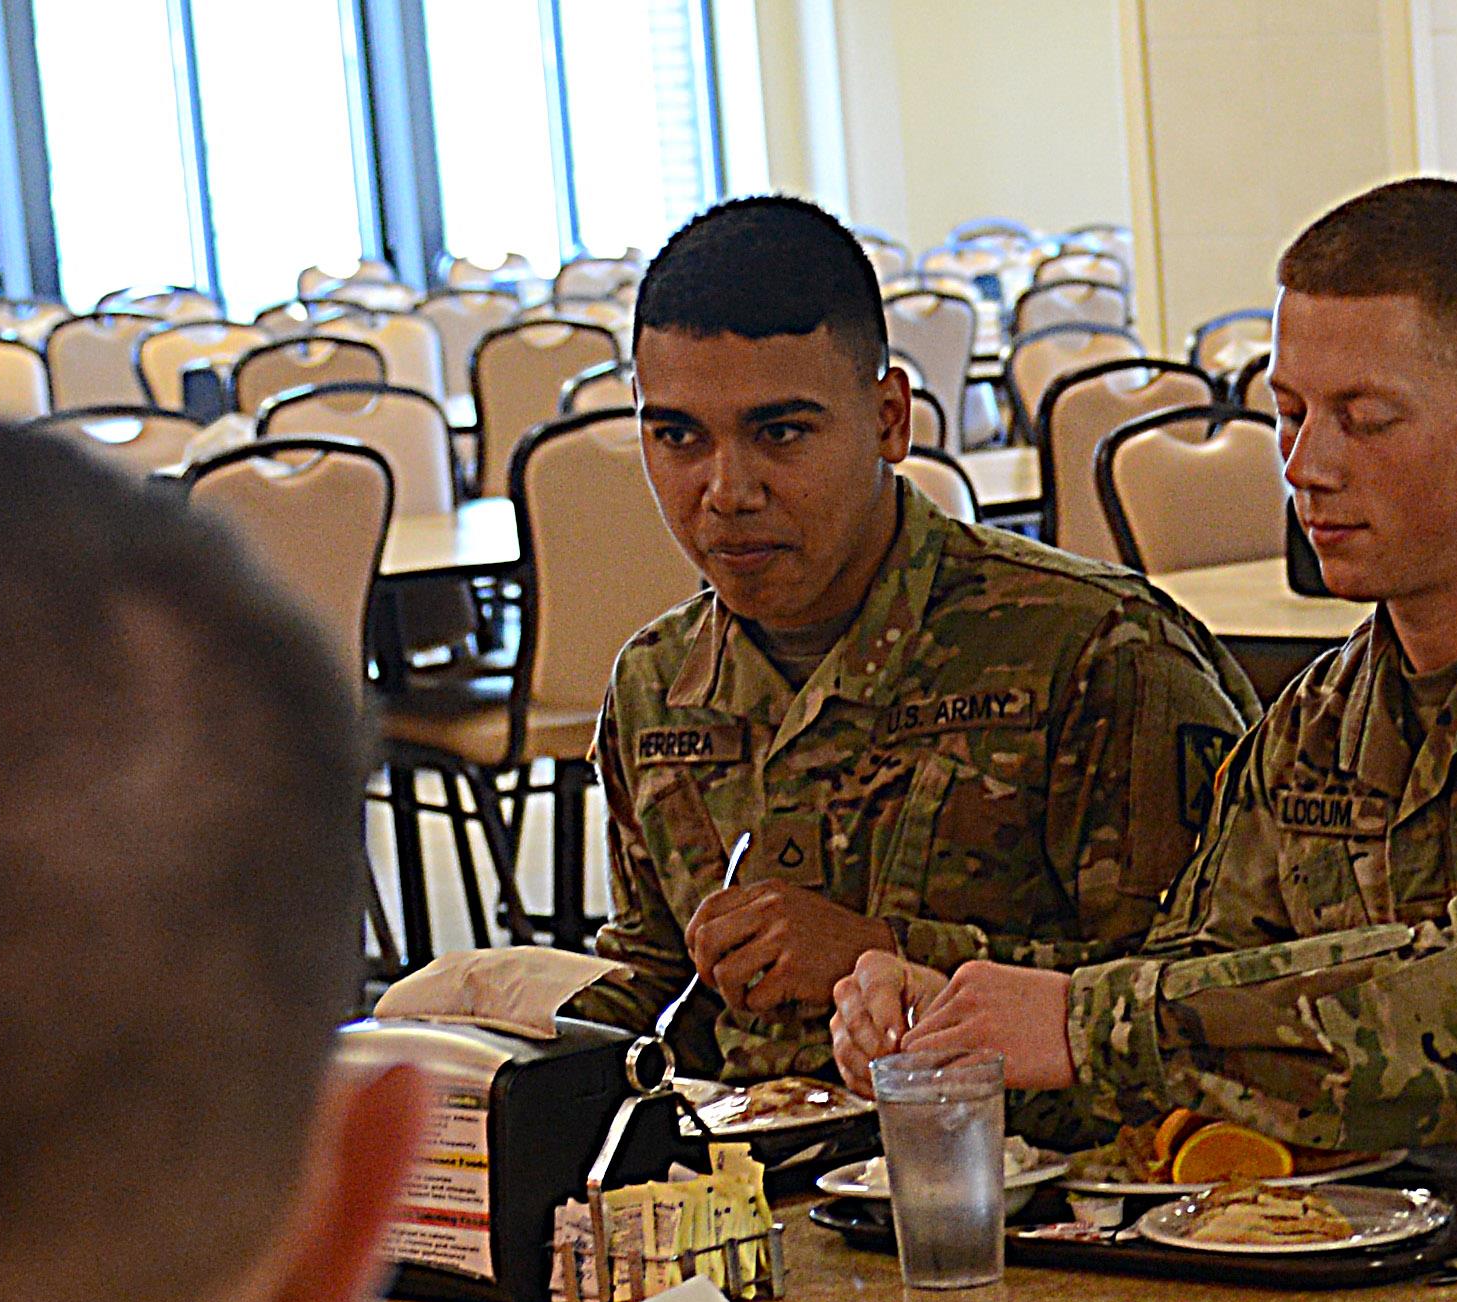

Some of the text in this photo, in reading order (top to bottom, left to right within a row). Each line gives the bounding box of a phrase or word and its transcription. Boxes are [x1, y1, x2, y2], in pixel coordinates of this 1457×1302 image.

[887, 691, 1013, 735] U.S. ARMY
[639, 729, 714, 758] HERRERA
[1280, 798, 1353, 828] LOCUM
